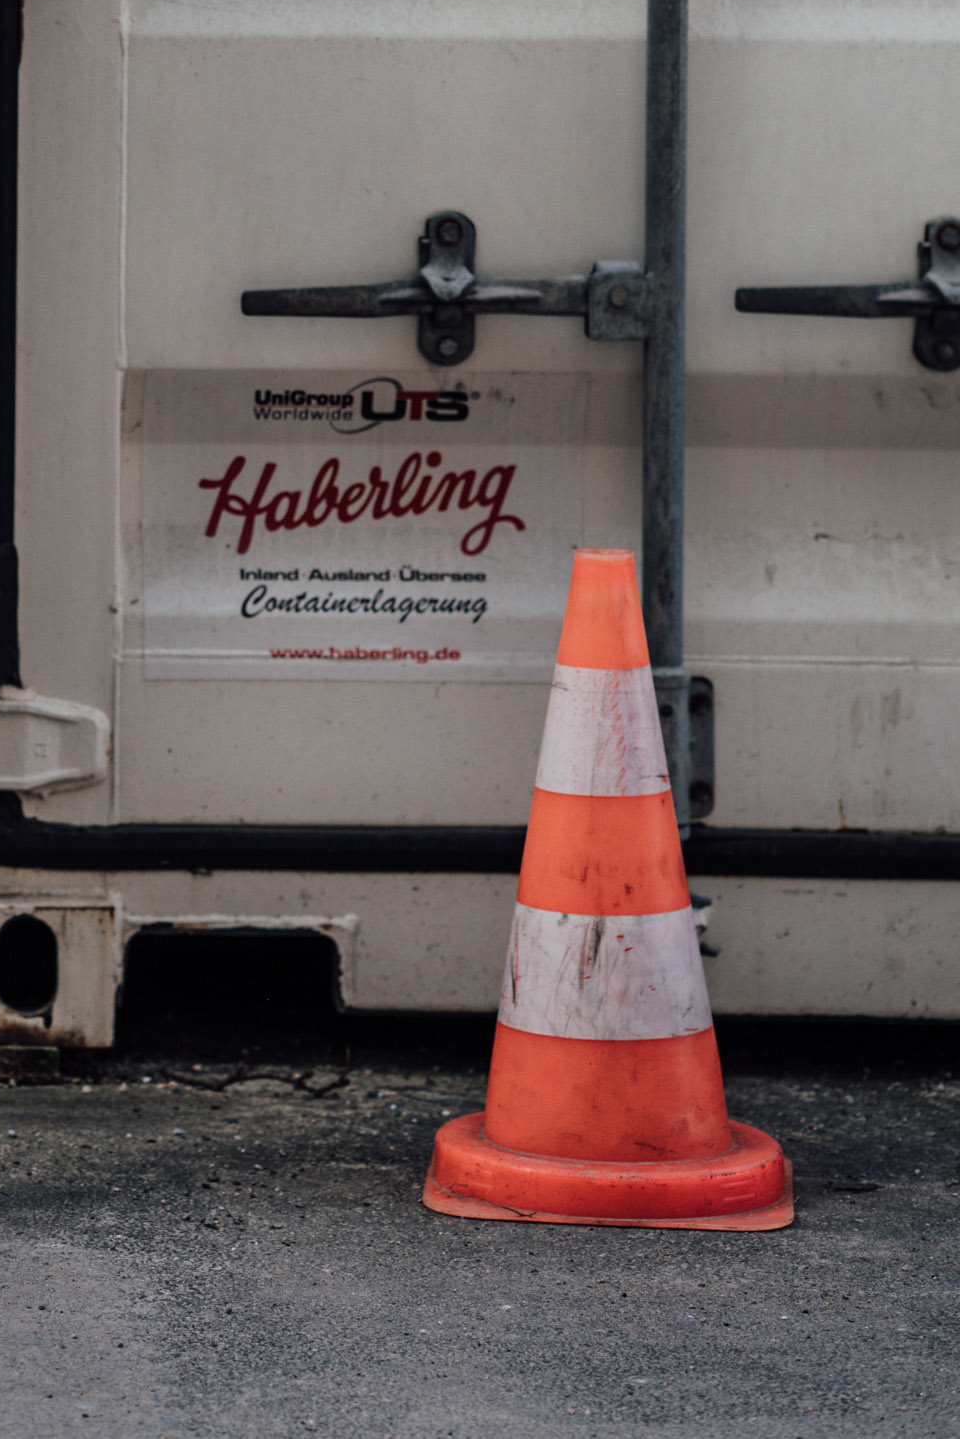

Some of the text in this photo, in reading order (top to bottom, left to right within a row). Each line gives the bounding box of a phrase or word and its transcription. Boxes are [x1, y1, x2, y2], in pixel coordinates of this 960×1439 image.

[253, 408, 354, 421] Worldwide
[254, 389, 470, 422] UniGroup UTS
[197, 449, 528, 558] Haberling
[239, 564, 487, 583] Inland Ausland Übersee
[240, 584, 488, 624] Containerlagerung
[270, 646, 461, 664] www.haberling.de
